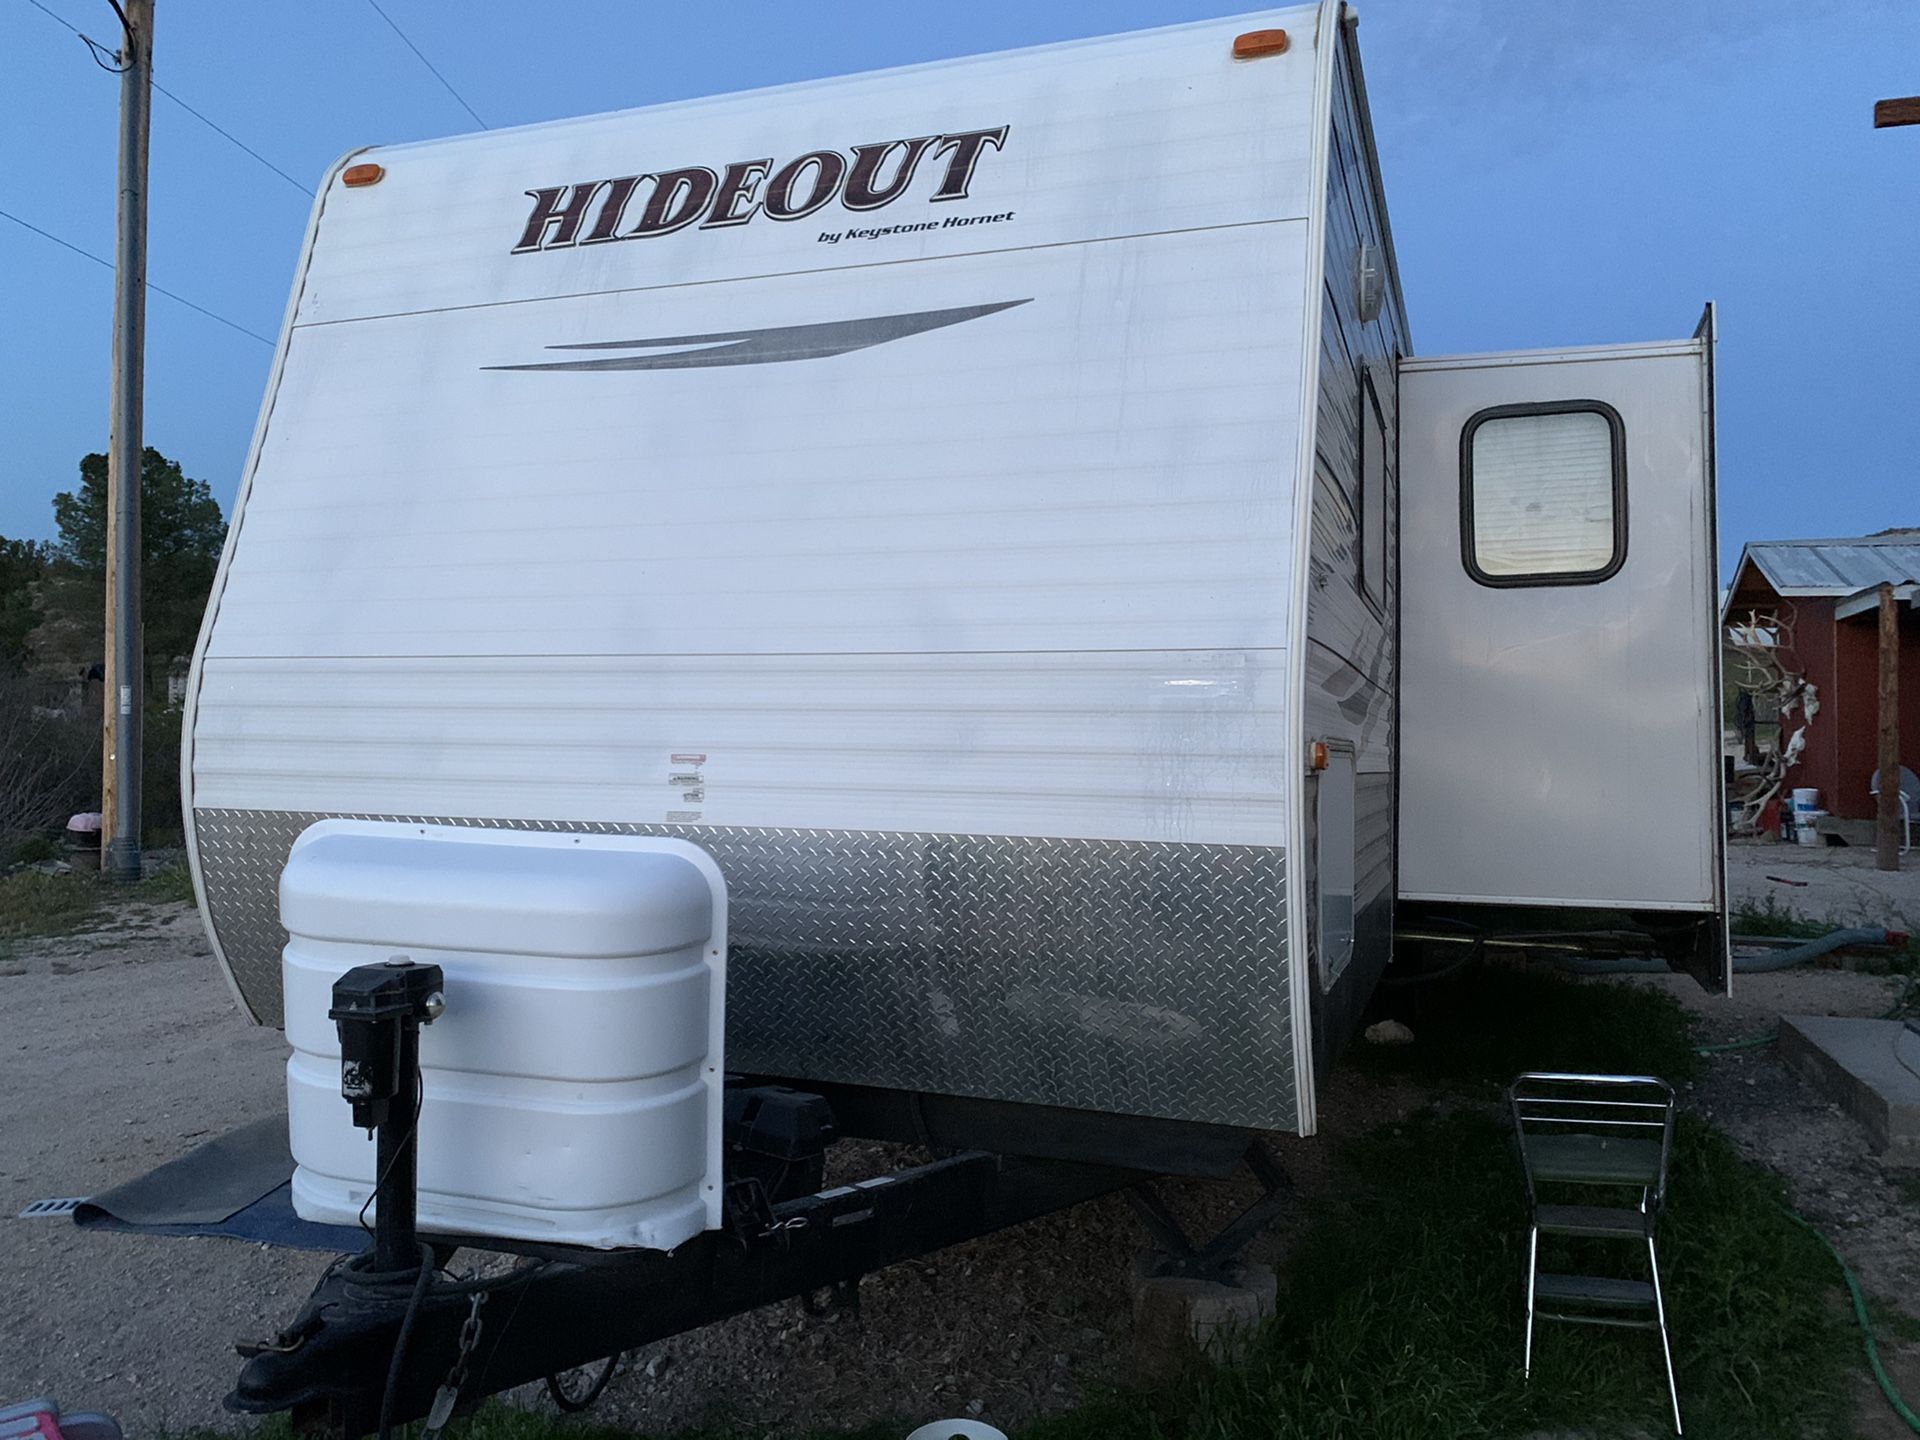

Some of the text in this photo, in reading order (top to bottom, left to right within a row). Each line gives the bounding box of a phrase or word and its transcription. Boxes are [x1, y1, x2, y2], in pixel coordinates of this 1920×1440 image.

[510, 125, 1010, 254] HIDEOUT
[817, 211, 1016, 244] by Keystone Hornet
